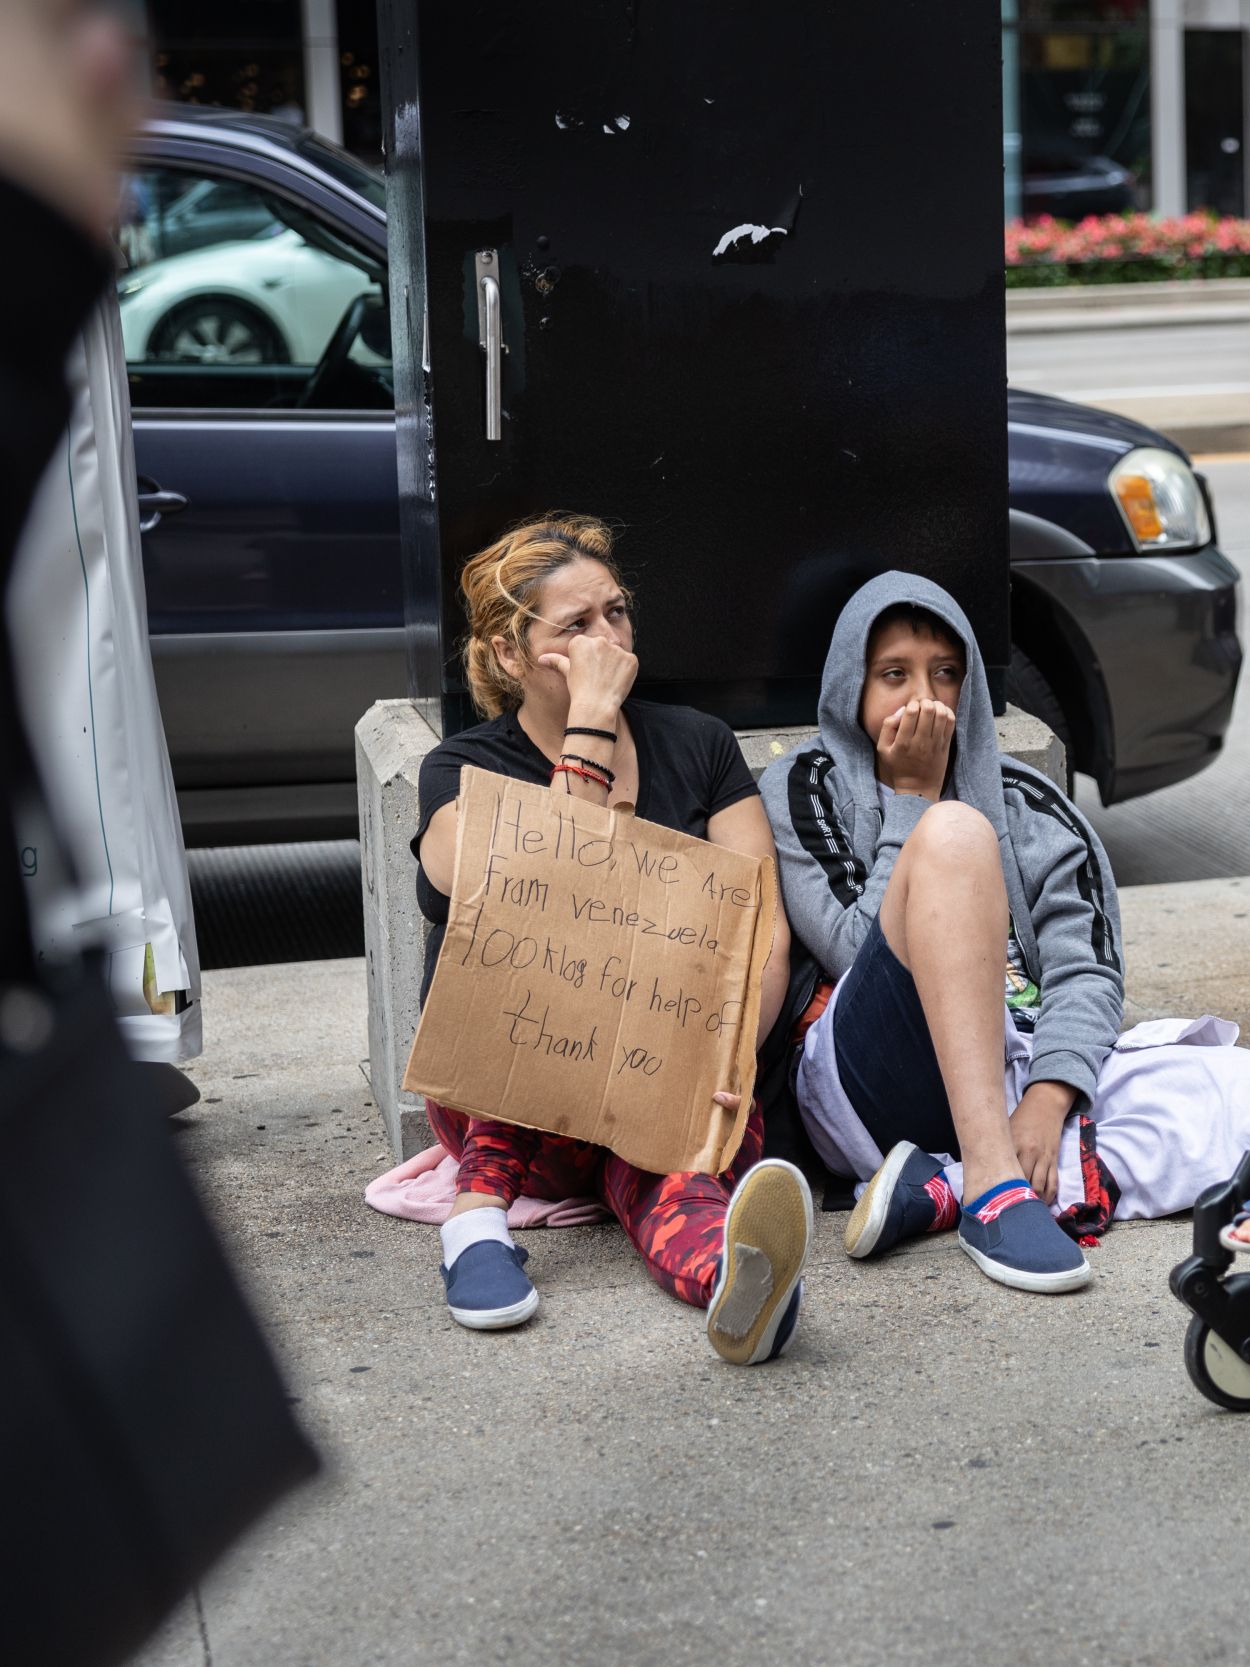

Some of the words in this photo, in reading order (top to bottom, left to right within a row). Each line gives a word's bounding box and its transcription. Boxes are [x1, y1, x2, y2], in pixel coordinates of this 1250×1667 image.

[490, 791, 617, 872] Hello,
[701, 871, 758, 909] Are
[502, 989, 598, 1062] thank
[600, 956, 638, 1001] for
[649, 976, 702, 1028] help
[705, 1000, 744, 1039] of
